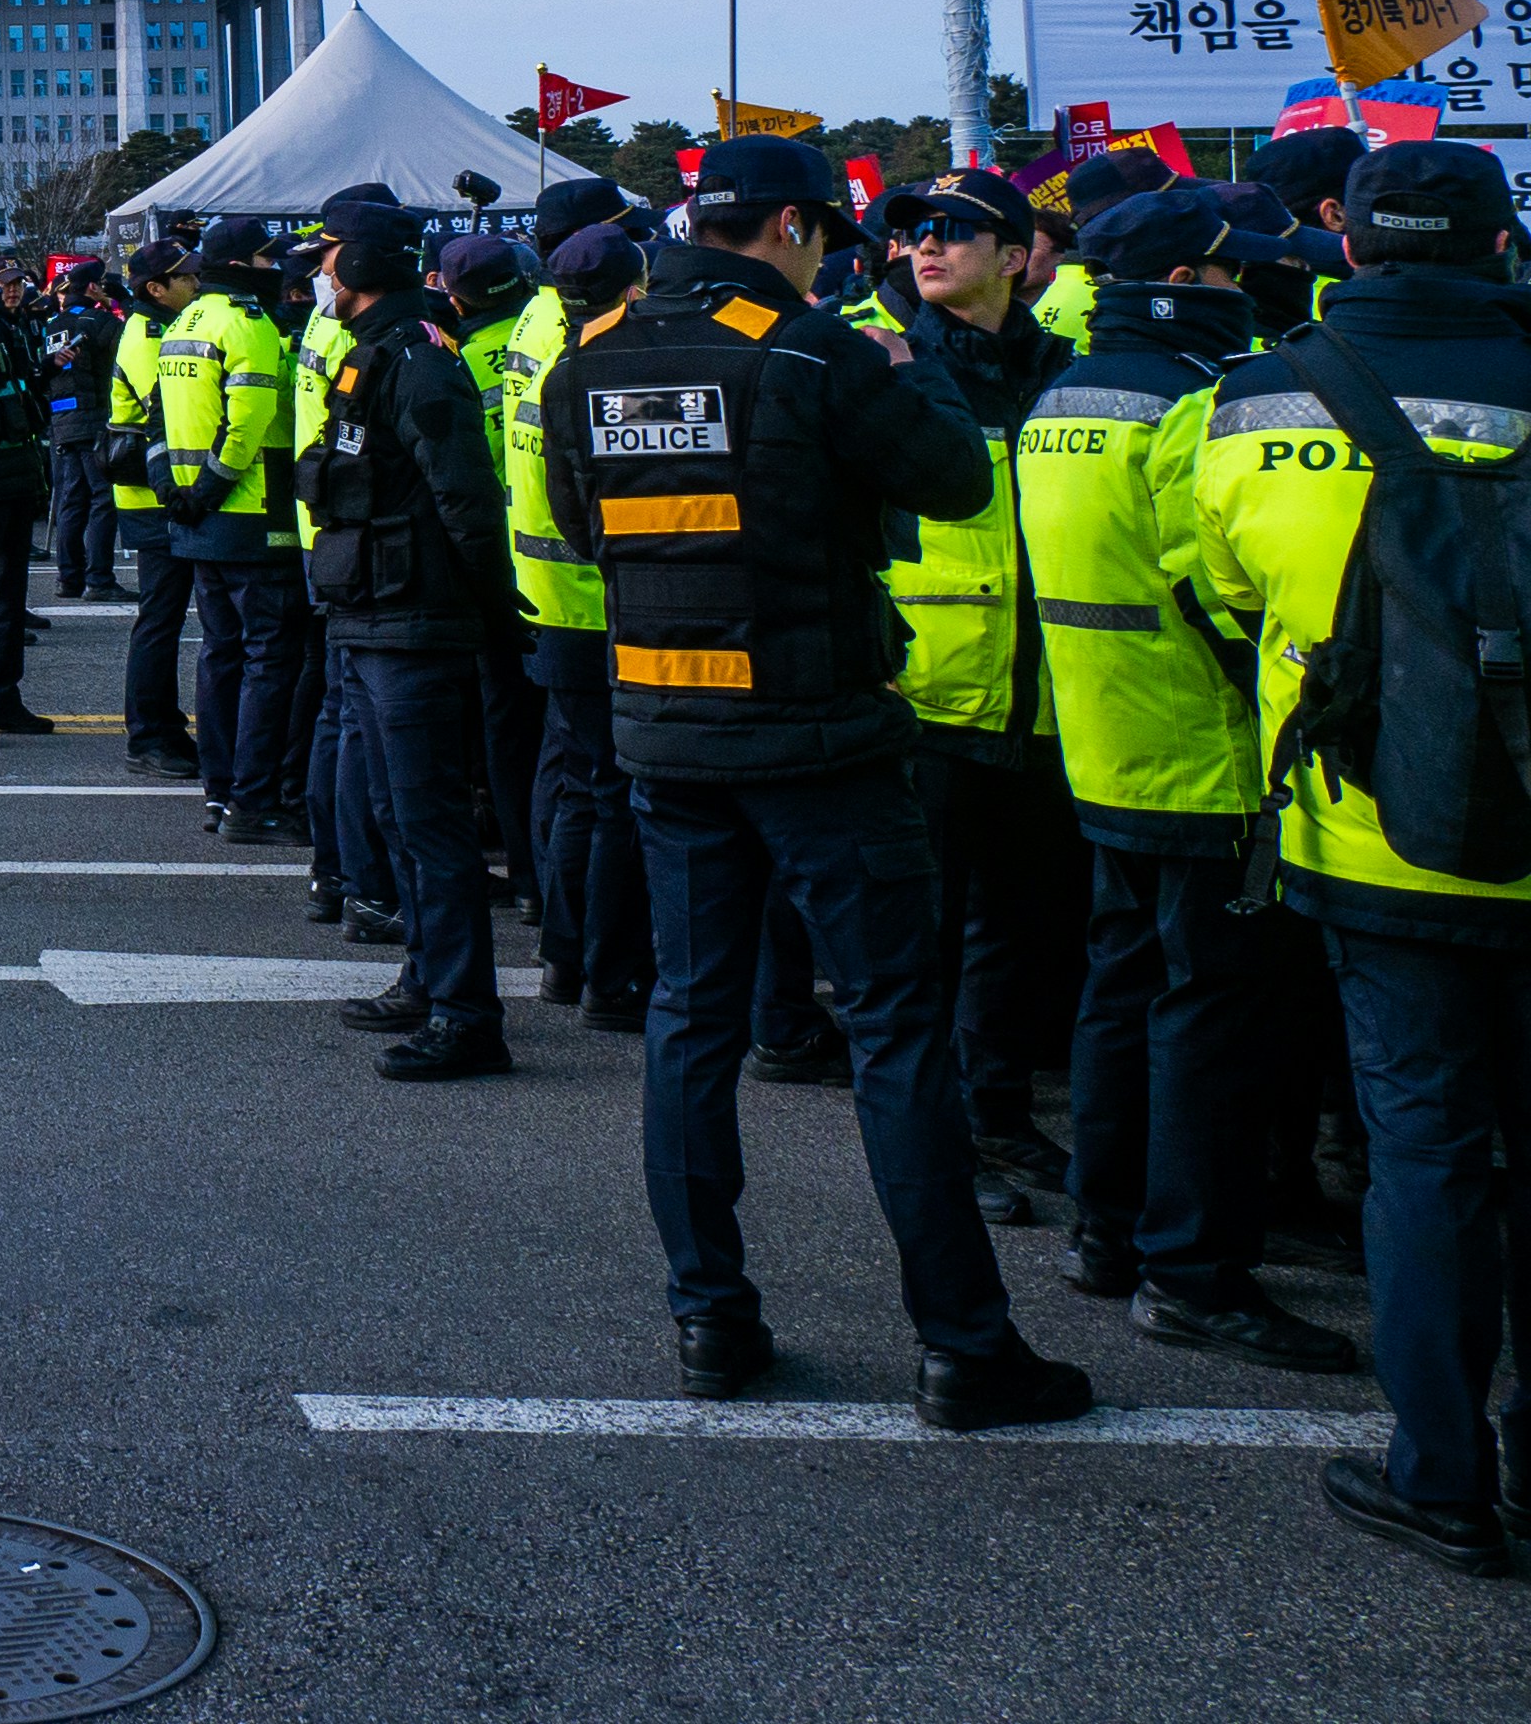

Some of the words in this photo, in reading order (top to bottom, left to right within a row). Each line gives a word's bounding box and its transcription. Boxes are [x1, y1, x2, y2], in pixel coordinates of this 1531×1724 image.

[725, 118, 762, 134] 기북
[761, 114, 798, 133] 2기-2
[1068, 139, 1109, 162] 키자
[699, 192, 733, 205] POLICE
[1380, 215, 1447, 230] POLICE
[604, 426, 711, 452] POLICE
[1258, 439, 1375, 473] POL
